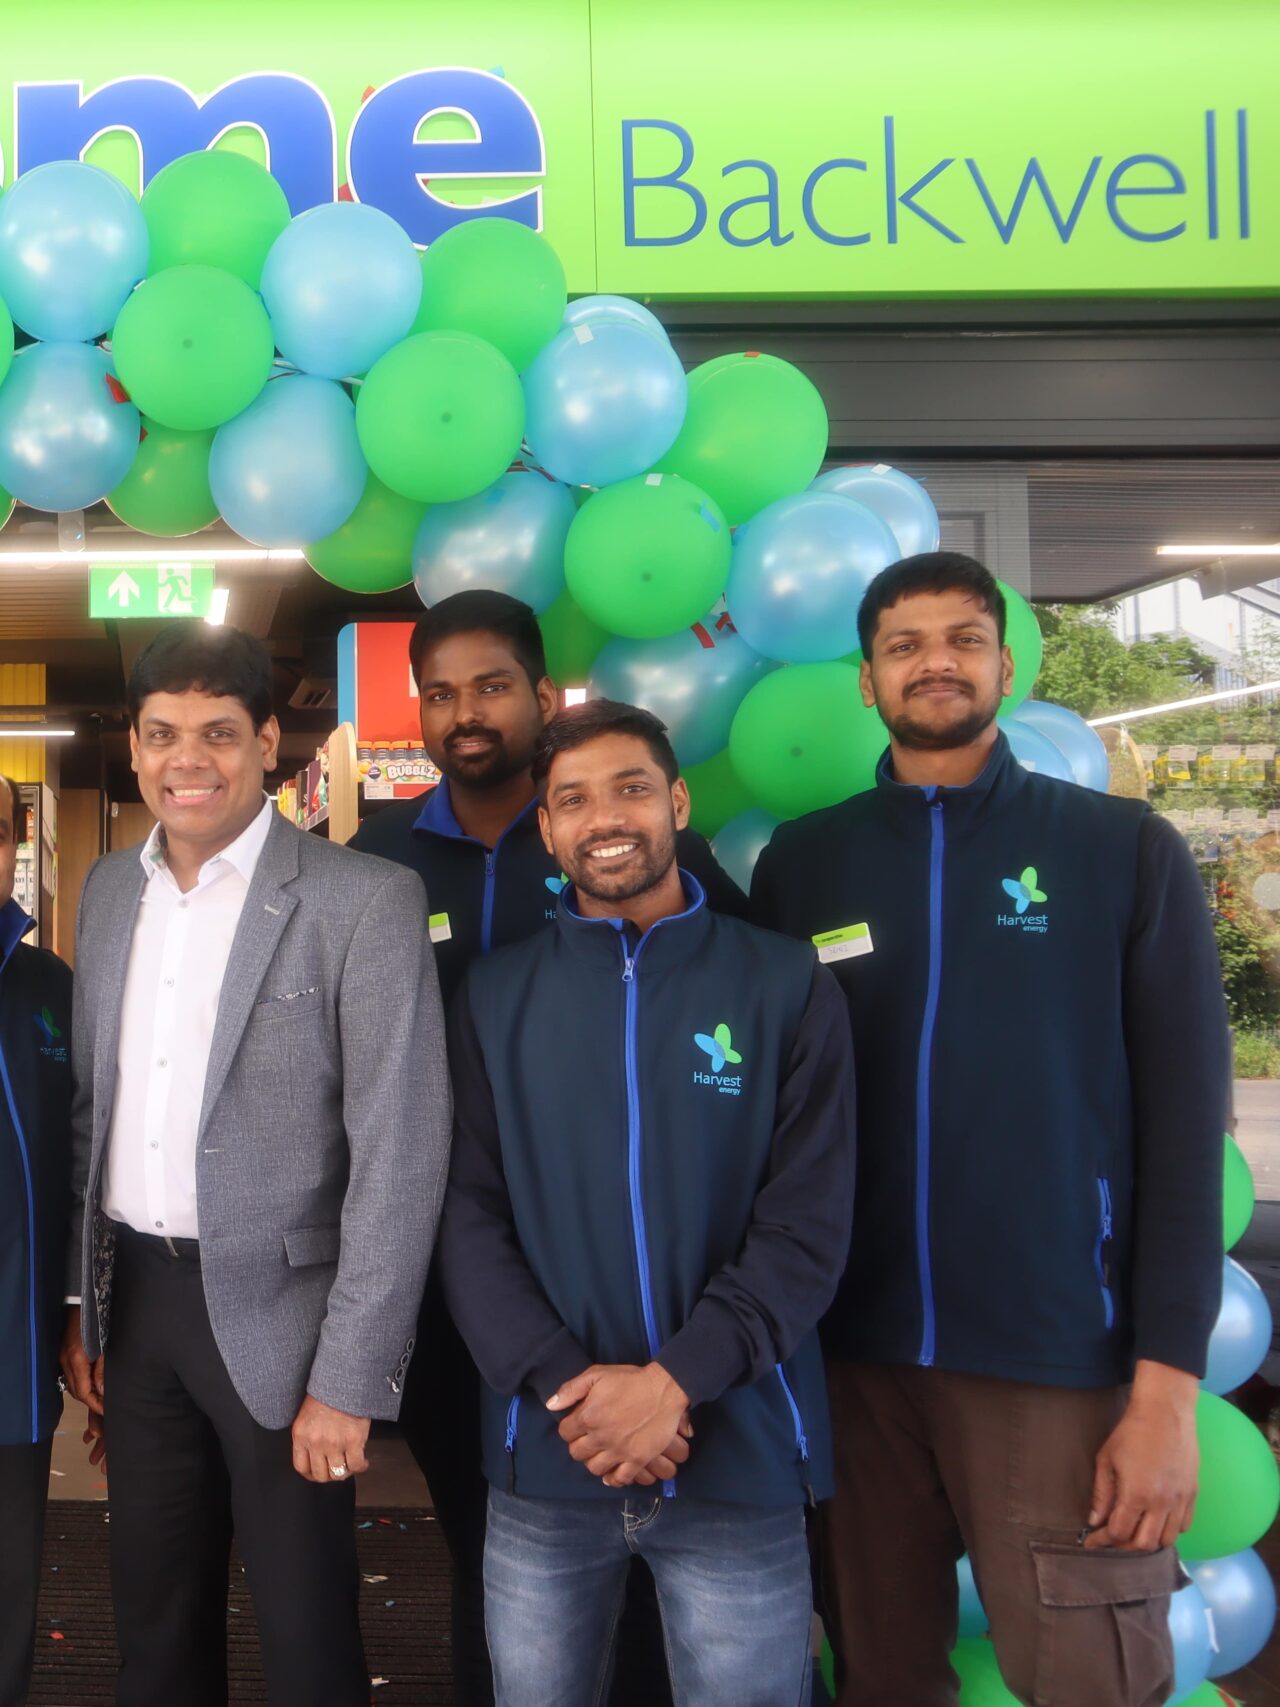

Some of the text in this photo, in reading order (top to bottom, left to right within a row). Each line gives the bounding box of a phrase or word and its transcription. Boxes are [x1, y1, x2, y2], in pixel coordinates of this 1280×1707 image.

[620, 107, 1251, 247] Backwell
[997, 914, 1048, 926] Harvest
[694, 1071, 742, 1087] Harvest
[719, 1086, 741, 1096] energy
